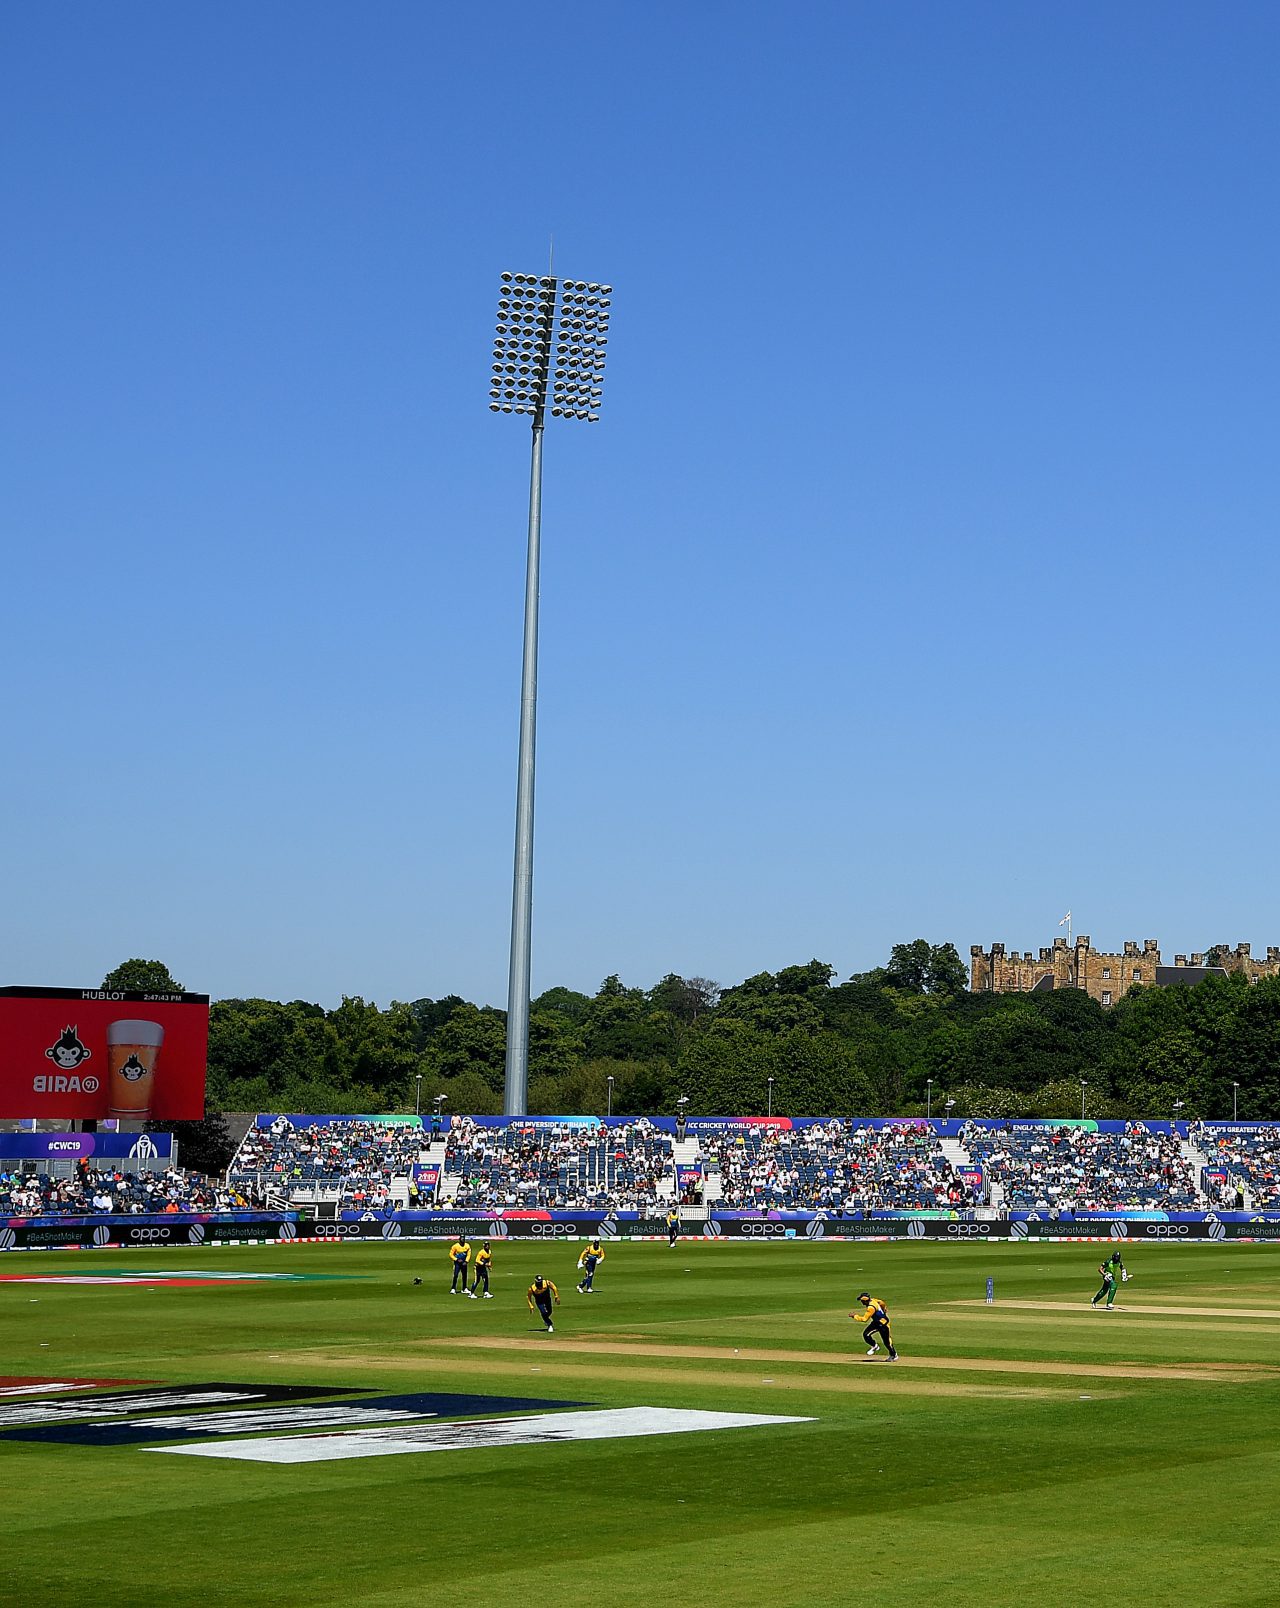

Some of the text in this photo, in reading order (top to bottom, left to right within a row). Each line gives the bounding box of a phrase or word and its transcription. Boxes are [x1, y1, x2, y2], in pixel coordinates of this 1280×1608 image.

[82, 991, 126, 1000] HUBLOT
[48, 1142, 80, 1150] #CWC19
[130, 1228, 170, 1240] oppo
[215, 1228, 268, 1236] #BeAShotMaker
[315, 1225, 360, 1236] oppo
[532, 1224, 576, 1235] oppo
[741, 1223, 785, 1235] oppo
[947, 1224, 990, 1235] oppo
[1147, 1225, 1188, 1236] oppo
[27, 1233, 82, 1242] #BeAShotMaker
